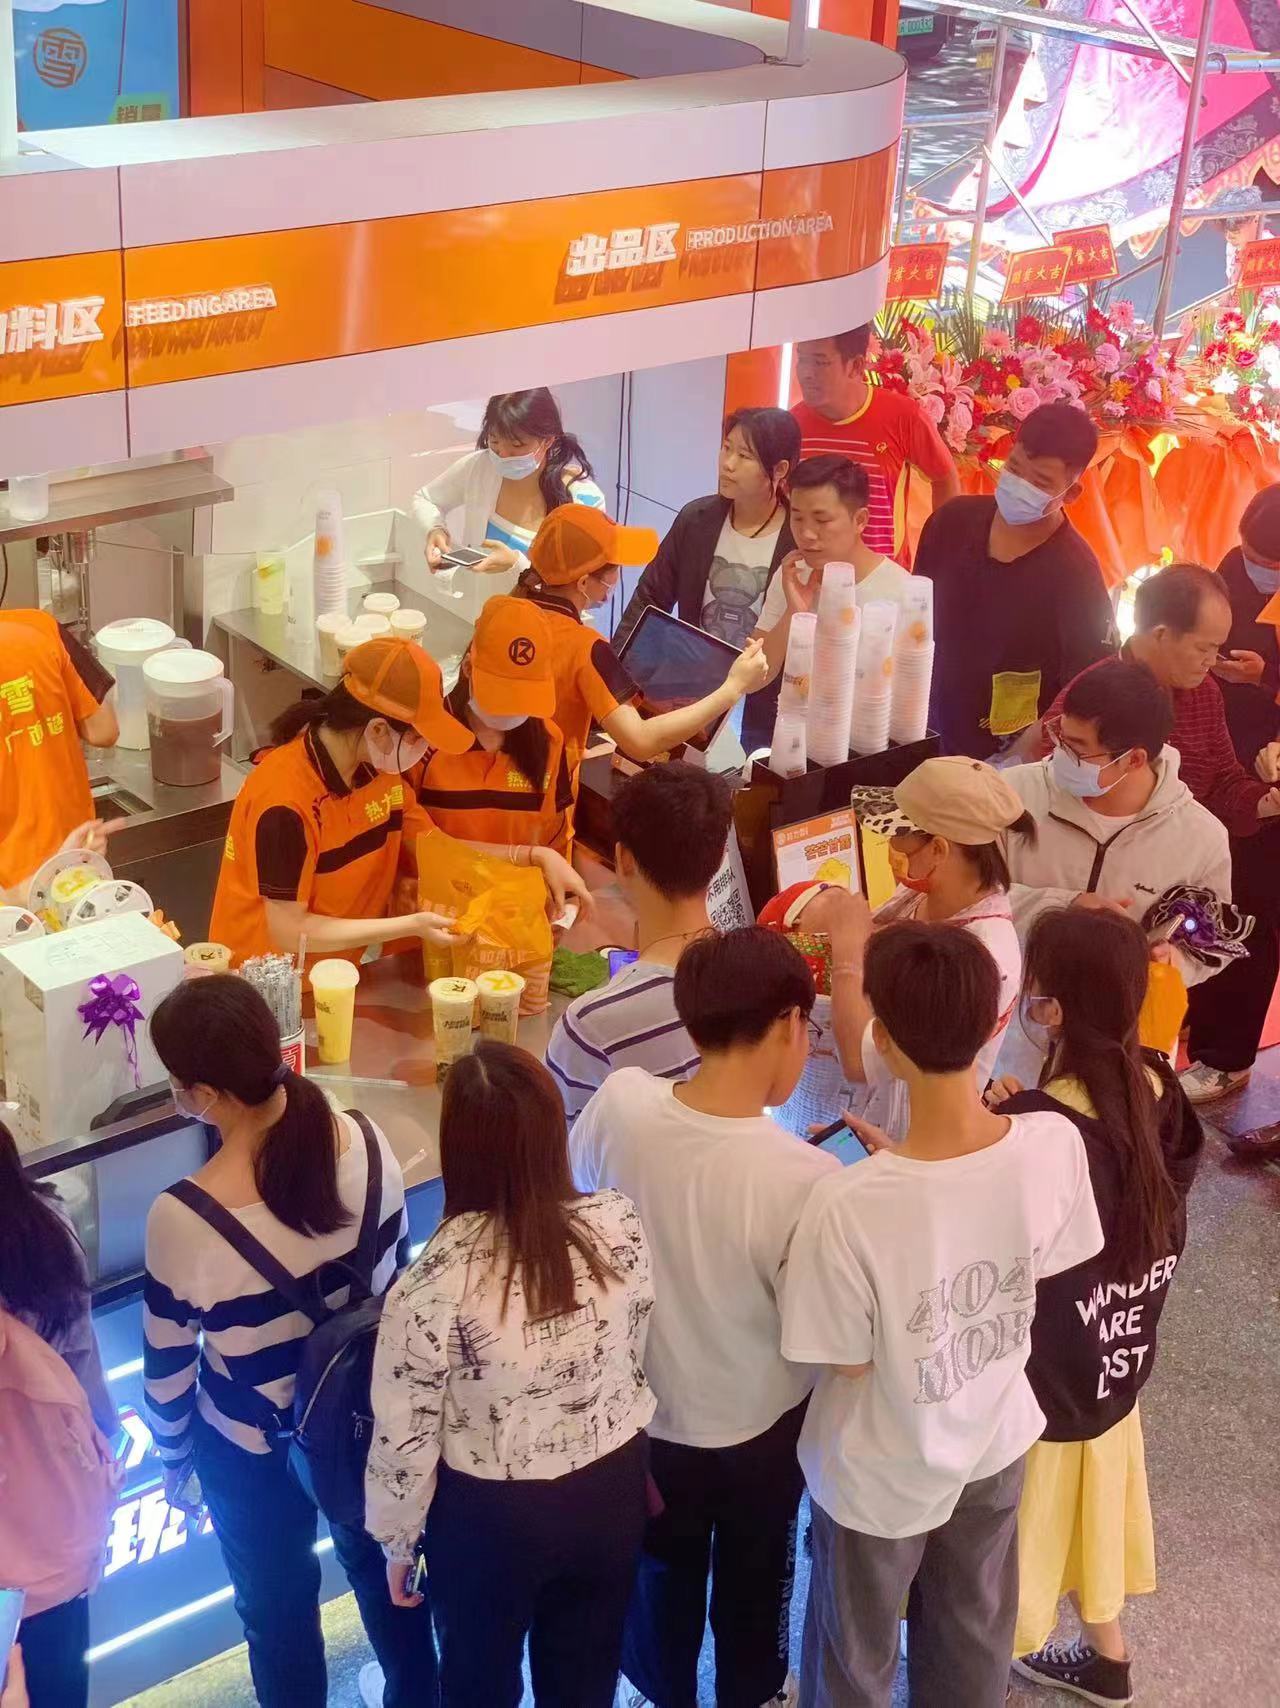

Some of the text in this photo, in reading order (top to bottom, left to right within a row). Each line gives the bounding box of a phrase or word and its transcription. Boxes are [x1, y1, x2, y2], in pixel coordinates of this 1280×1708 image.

[566, 222, 680, 277] 出品区
[686, 215, 834, 250] PRODUCTION AREA
[0, 296, 105, 354] 料区
[1099, 1304, 1144, 1344] ARE
[103, 1487, 200, 1578] 现
